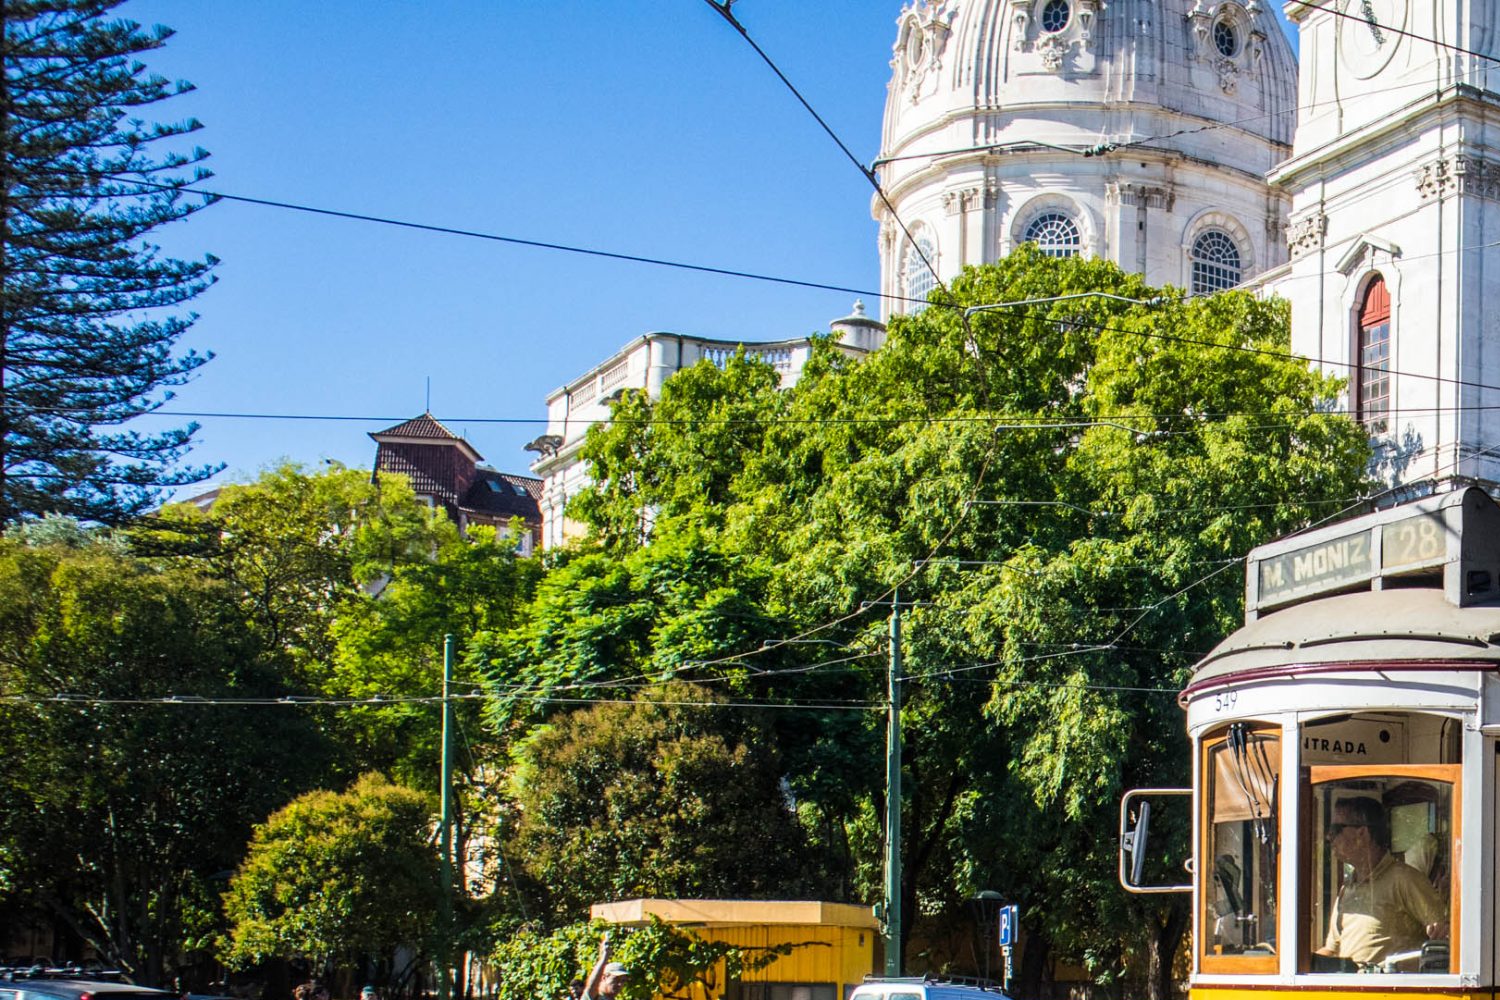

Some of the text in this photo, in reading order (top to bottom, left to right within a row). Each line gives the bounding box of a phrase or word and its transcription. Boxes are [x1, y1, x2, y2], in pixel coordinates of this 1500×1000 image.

[1399, 521, 1439, 561] 28
[1263, 537, 1367, 589] M. MONIZ
[1215, 689, 1238, 712] 549
[1001, 913, 1009, 939] P
